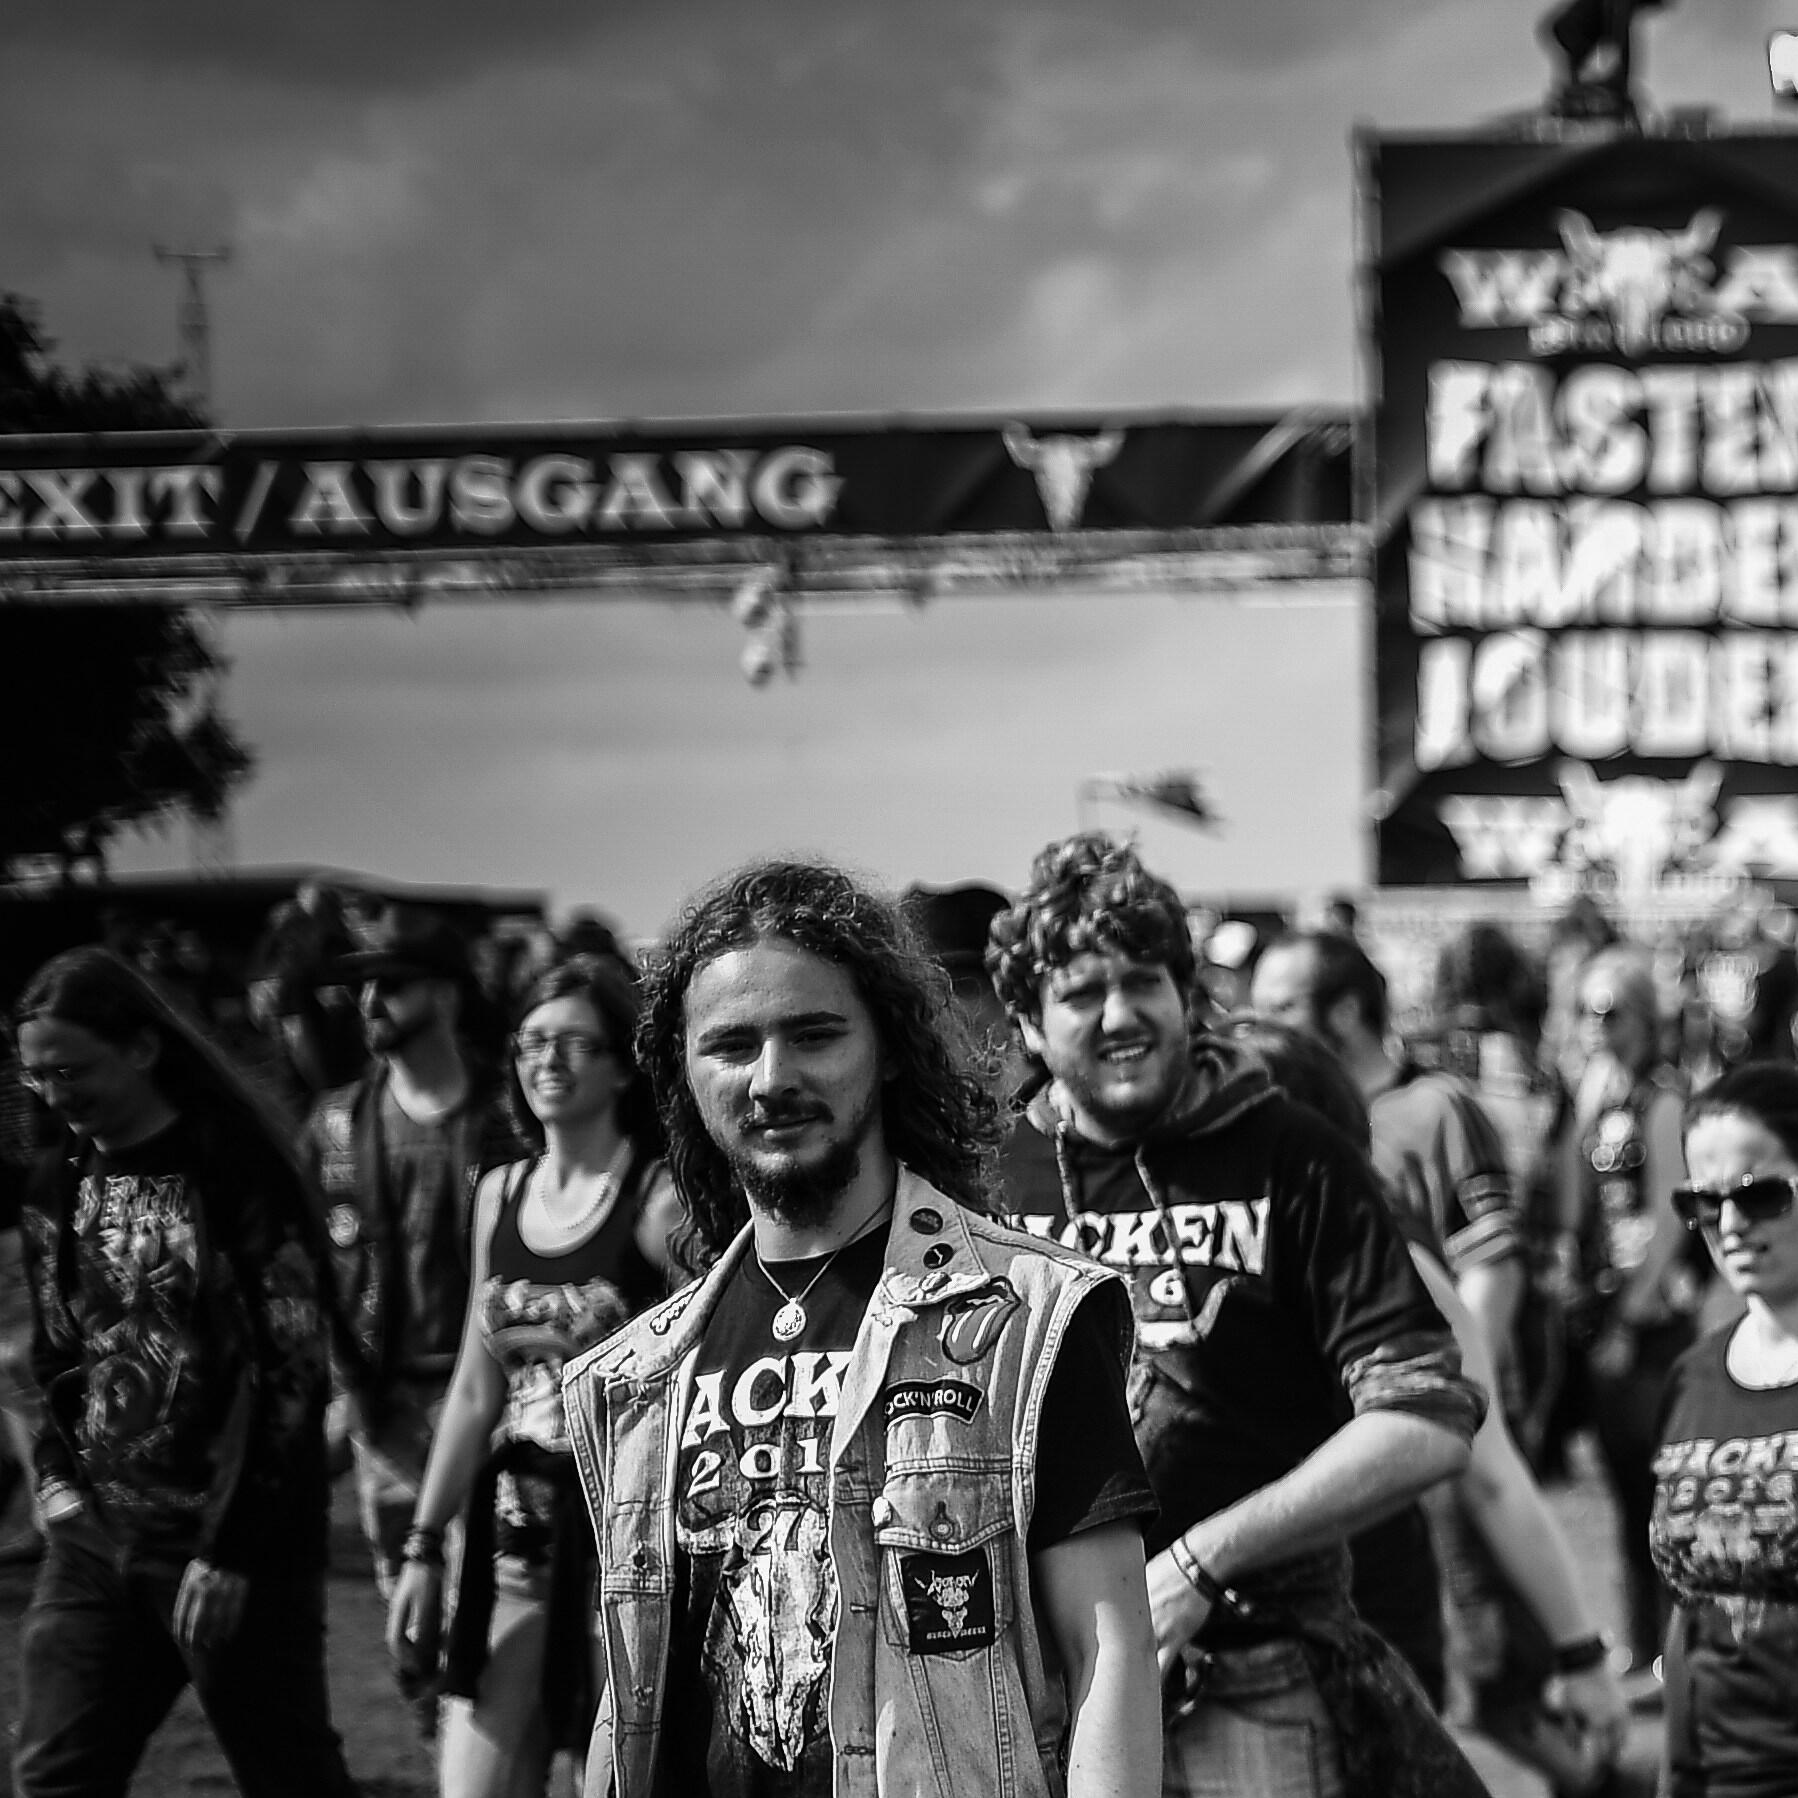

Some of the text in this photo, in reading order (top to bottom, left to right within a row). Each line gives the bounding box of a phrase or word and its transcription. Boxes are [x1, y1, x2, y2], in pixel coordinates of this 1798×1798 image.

[985, 1197, 1271, 1276] CKEN
[1149, 1267, 1188, 1306] 6
[680, 1350, 853, 1450] ACK
[884, 1388, 973, 1416] OCK'N'ROLL
[687, 1437, 826, 1499] 201
[746, 1503, 811, 1555] 27
